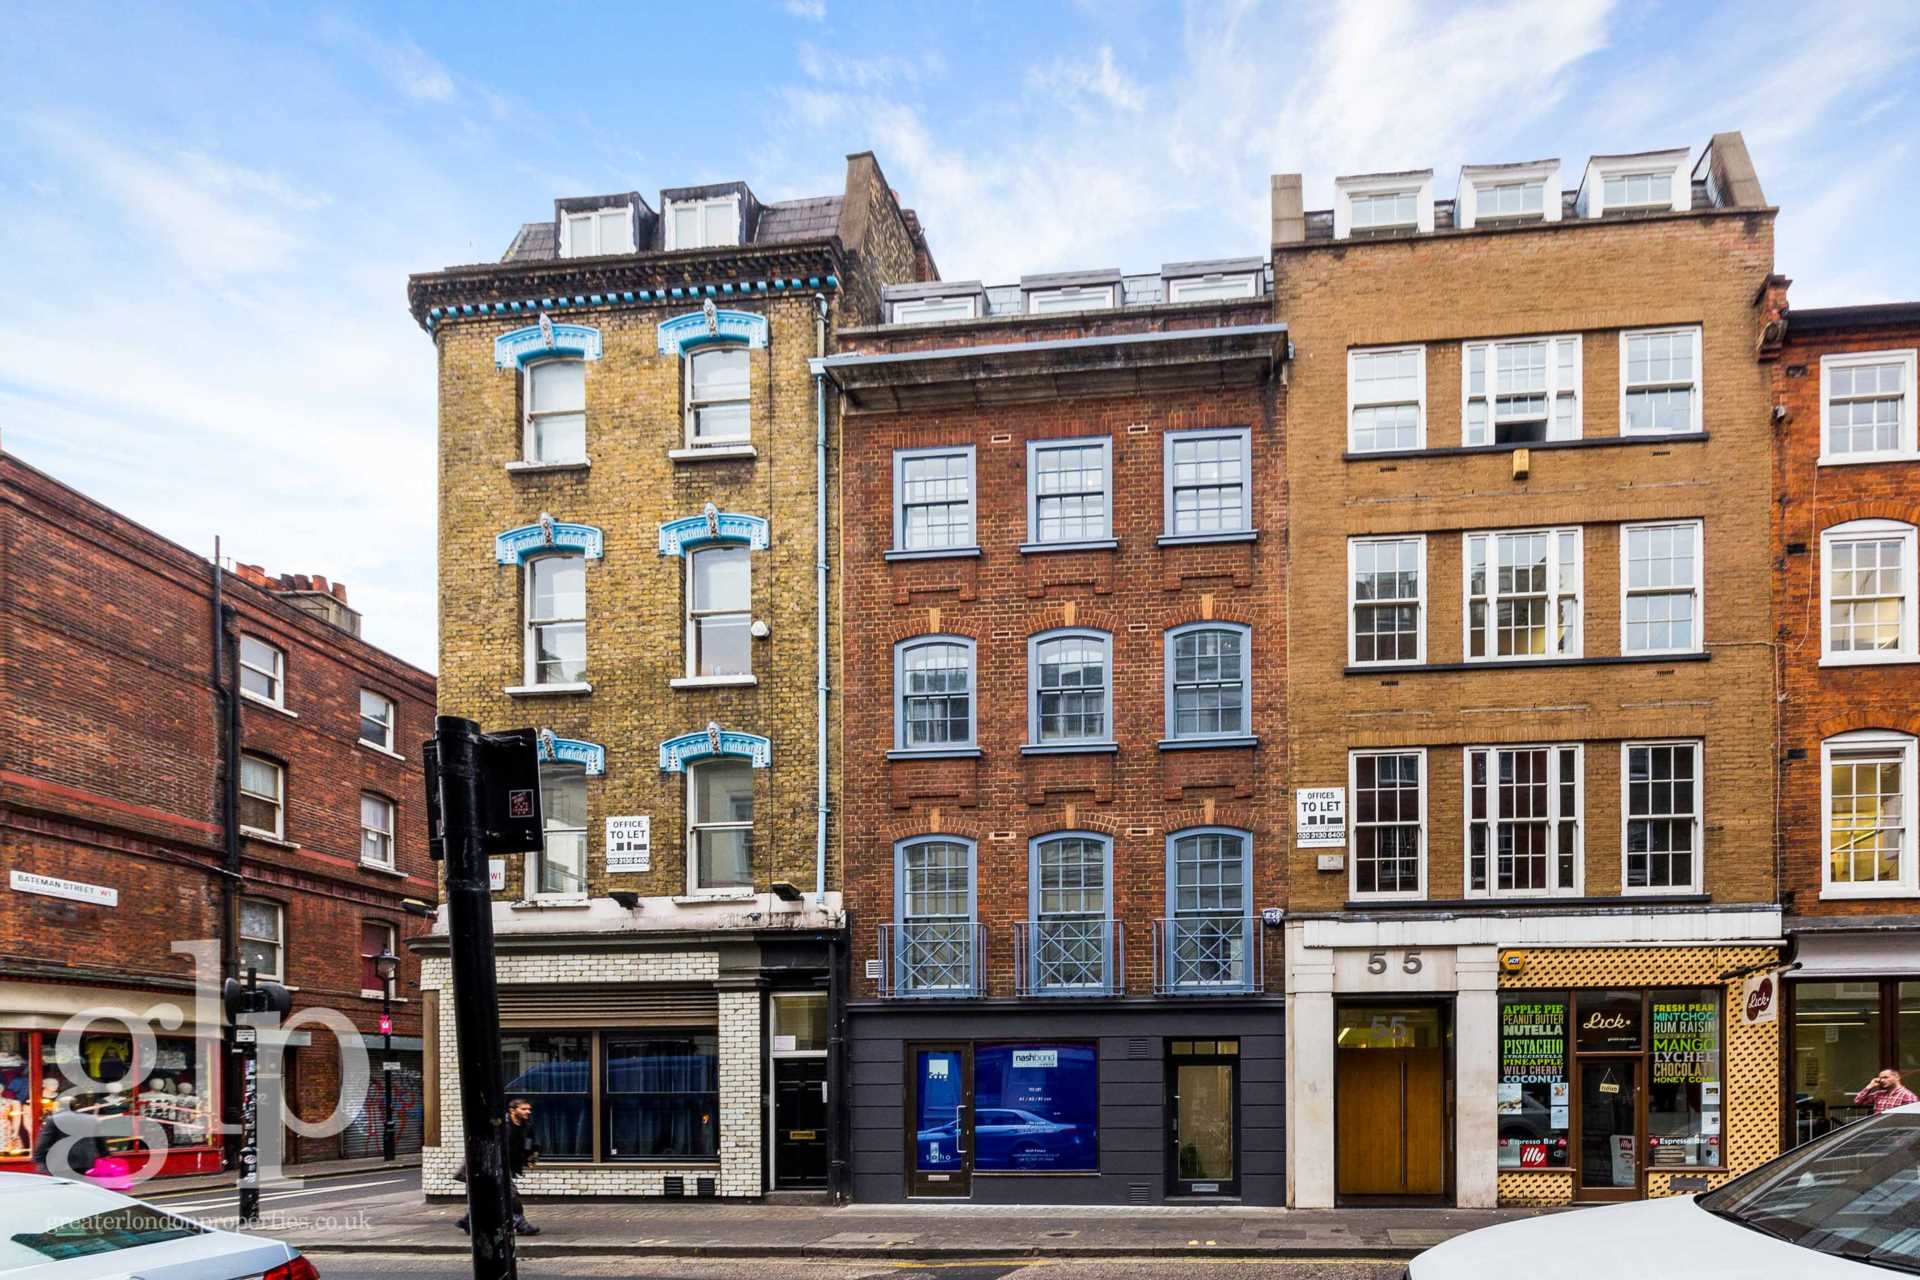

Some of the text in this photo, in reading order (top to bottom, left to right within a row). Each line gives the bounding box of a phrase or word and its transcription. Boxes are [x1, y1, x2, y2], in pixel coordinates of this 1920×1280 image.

[1307, 792, 1334, 800] OFFICES
[1301, 801, 1341, 812] TO LET
[610, 830, 645, 839] TO LET
[491, 872, 501, 880] W1
[18, 875, 61, 888] BATEMAN
[63, 882, 94, 894] STREET
[1503, 1004, 1564, 1014] APPLE PIE
[1654, 1004, 1714, 1012] FRESH PEAR
[1503, 1014, 1564, 1025] PEANUT BUTTER
[1503, 1024, 1563, 1036] NUTELLA
[1654, 1021, 1714, 1033] RUM RAISIN
[1503, 1039, 1563, 1054] PISTACHIO
[1654, 1039, 1715, 1052] MANGO
[1503, 1058, 1564, 1066] PINEAPPLE
[1654, 1051, 1714, 1063] LYCHEE
[1503, 1066, 1563, 1075] WILD CHERRY
[1503, 1075, 1563, 1084] COCONUT
[1510, 1138, 1541, 1146] Espresso
[1522, 1147, 1545, 1166] illy
